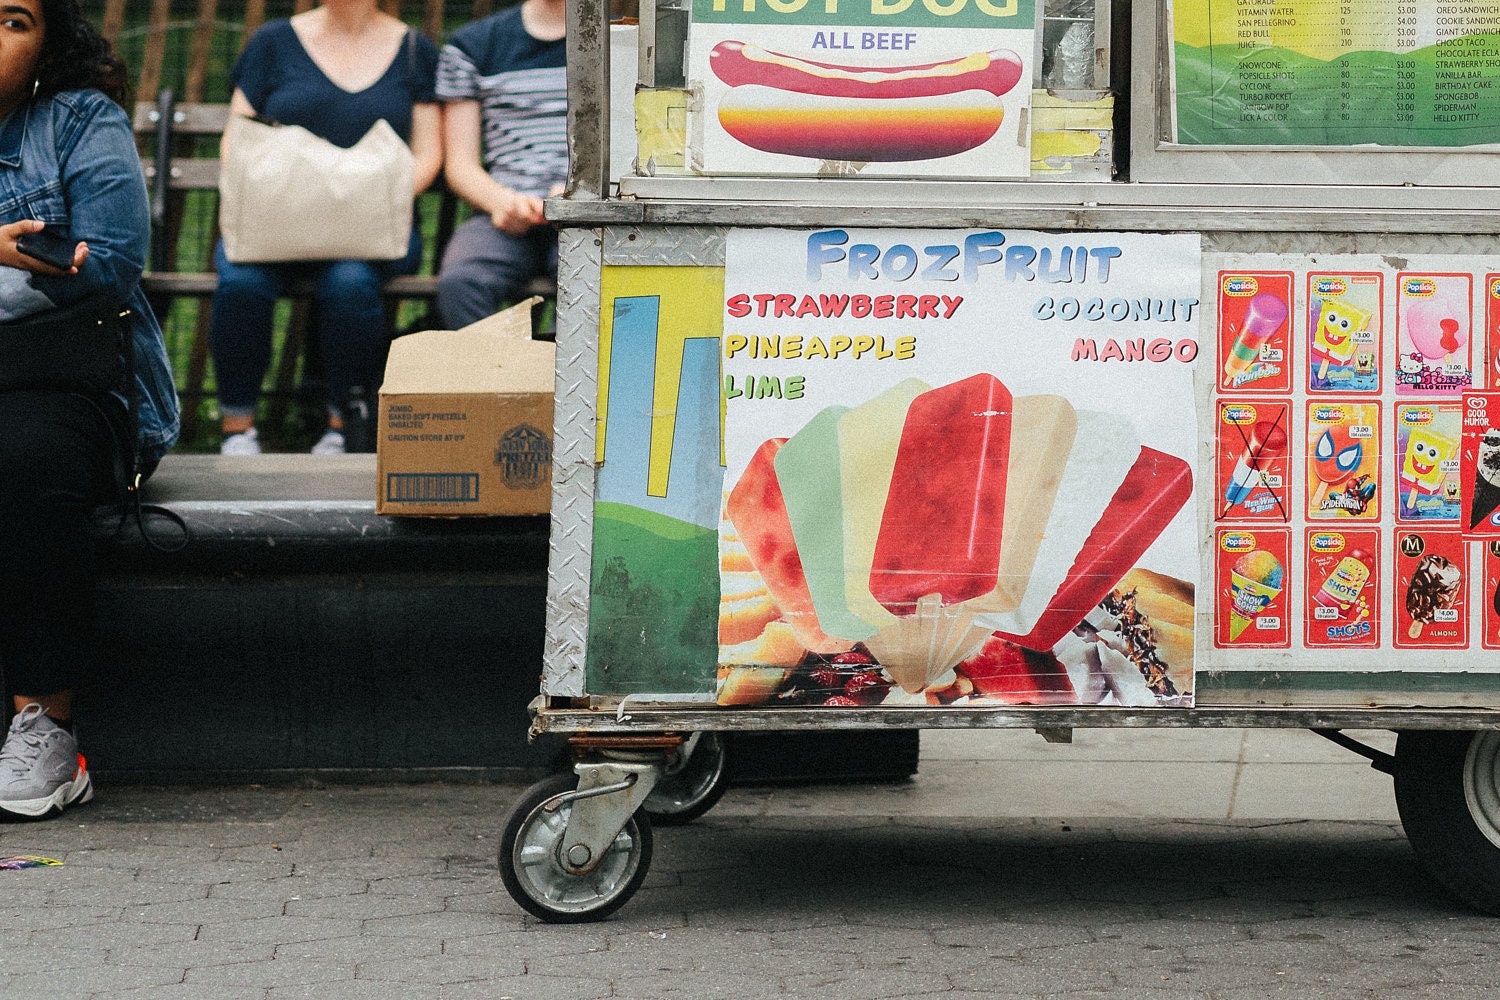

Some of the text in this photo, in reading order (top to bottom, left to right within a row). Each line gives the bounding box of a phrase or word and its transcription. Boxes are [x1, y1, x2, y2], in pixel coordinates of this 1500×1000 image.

[811, 31, 918, 51] ALL BEEF
[1239, 61, 1281, 70] SNOWCONE
[1435, 92, 1479, 101] SPONGEBOB
[726, 293, 964, 319] STRAWBERRY
[1032, 296, 1200, 322] COCONUT
[725, 335, 917, 360] PINEAPPLE
[1071, 337, 1199, 363] MANGO
[1233, 365, 1282, 388] Rainbow
[724, 374, 806, 400] LIME
[1464, 417, 1490, 427] HUMOR
[1467, 409, 1486, 419] GOOD
[1327, 622, 1371, 638] SHOTS
[1429, 630, 1458, 638] ALMOND
